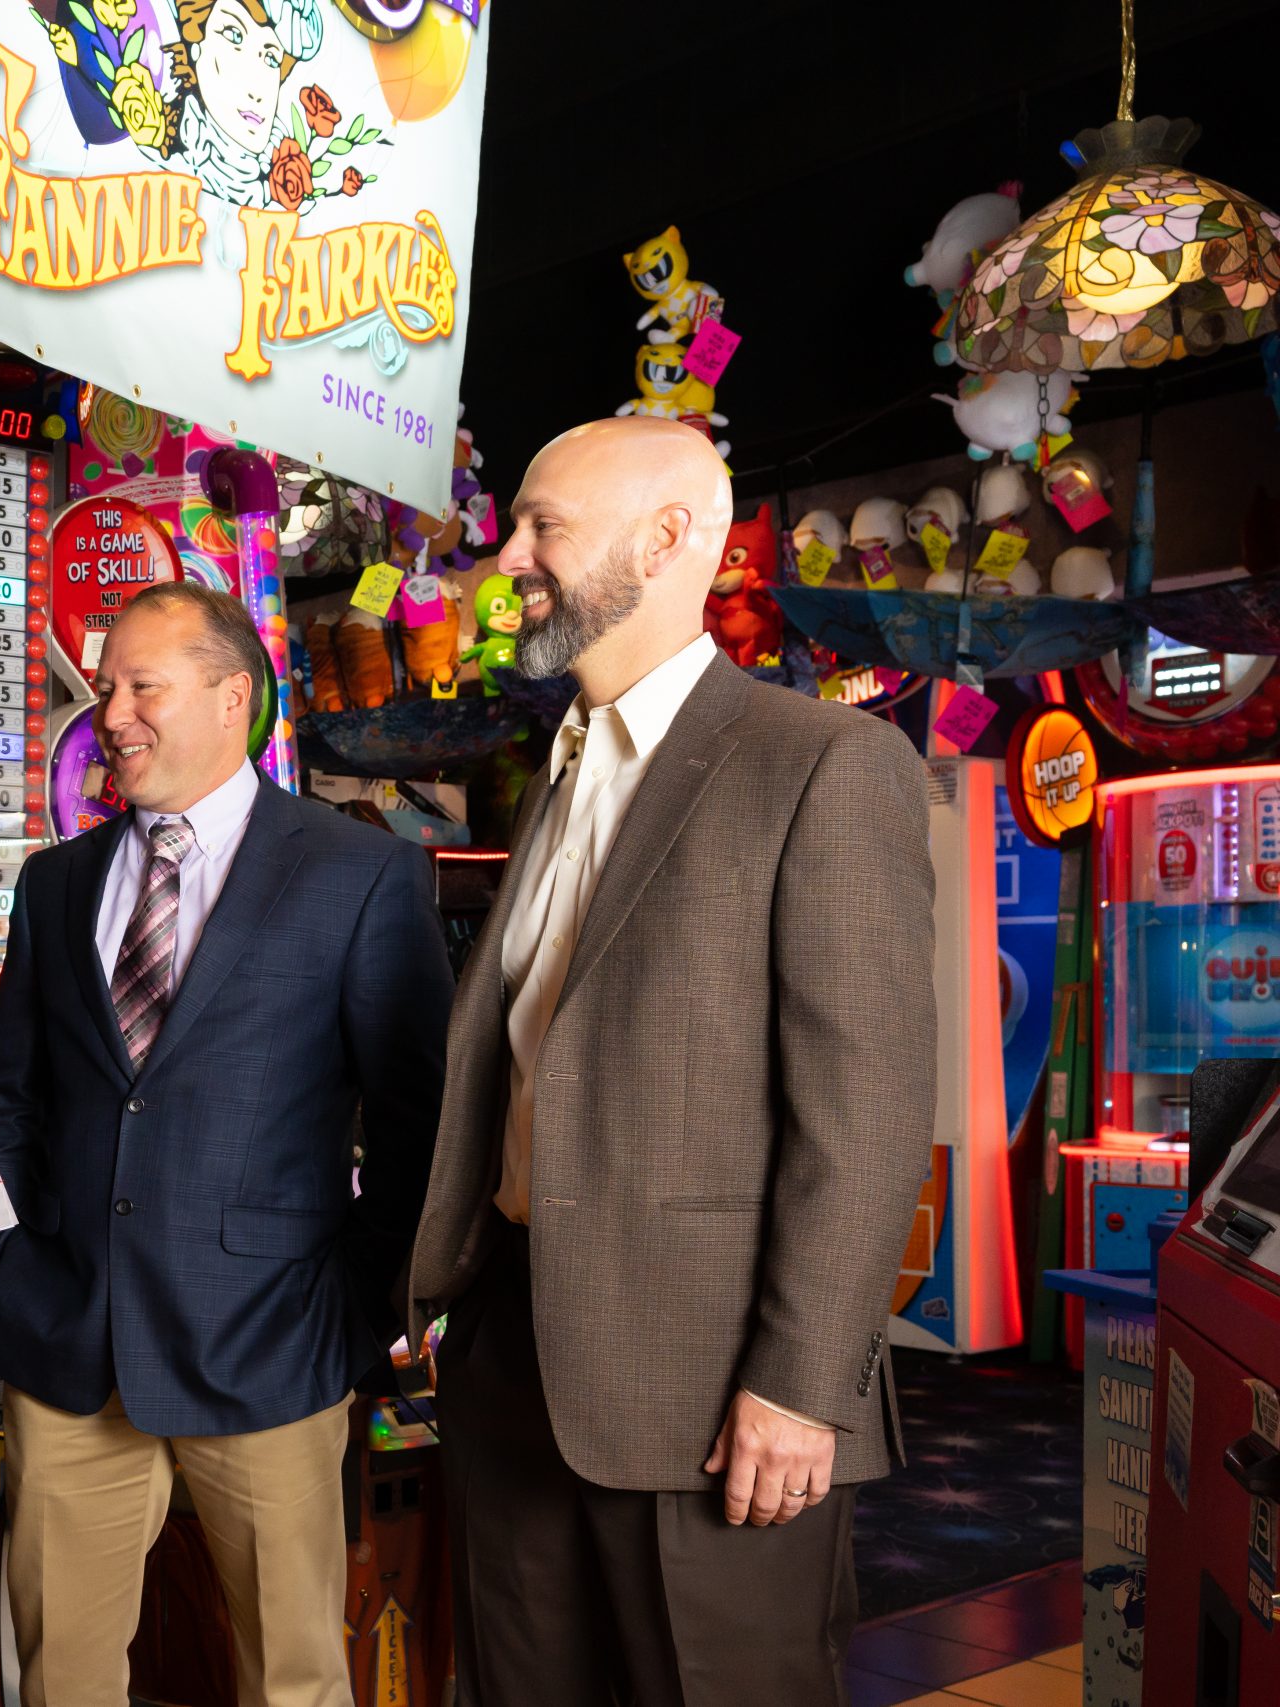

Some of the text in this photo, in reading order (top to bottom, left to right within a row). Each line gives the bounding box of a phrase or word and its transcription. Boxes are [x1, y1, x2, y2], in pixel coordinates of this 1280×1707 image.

[224, 206, 456, 382] FARKLE'S
[323, 374, 433, 448] SINCE 1981
[0, 453, 7, 466] 5
[93, 510, 122, 528] THIS
[76, 533, 145, 553] IS A GAME
[68, 556, 155, 585] OF SKILL!
[101, 592, 122, 607] NOT
[1034, 750, 1085, 787] HOOP
[1046, 781, 1080, 808] IT UP
[387, 1609, 397, 1702] TICKETS
